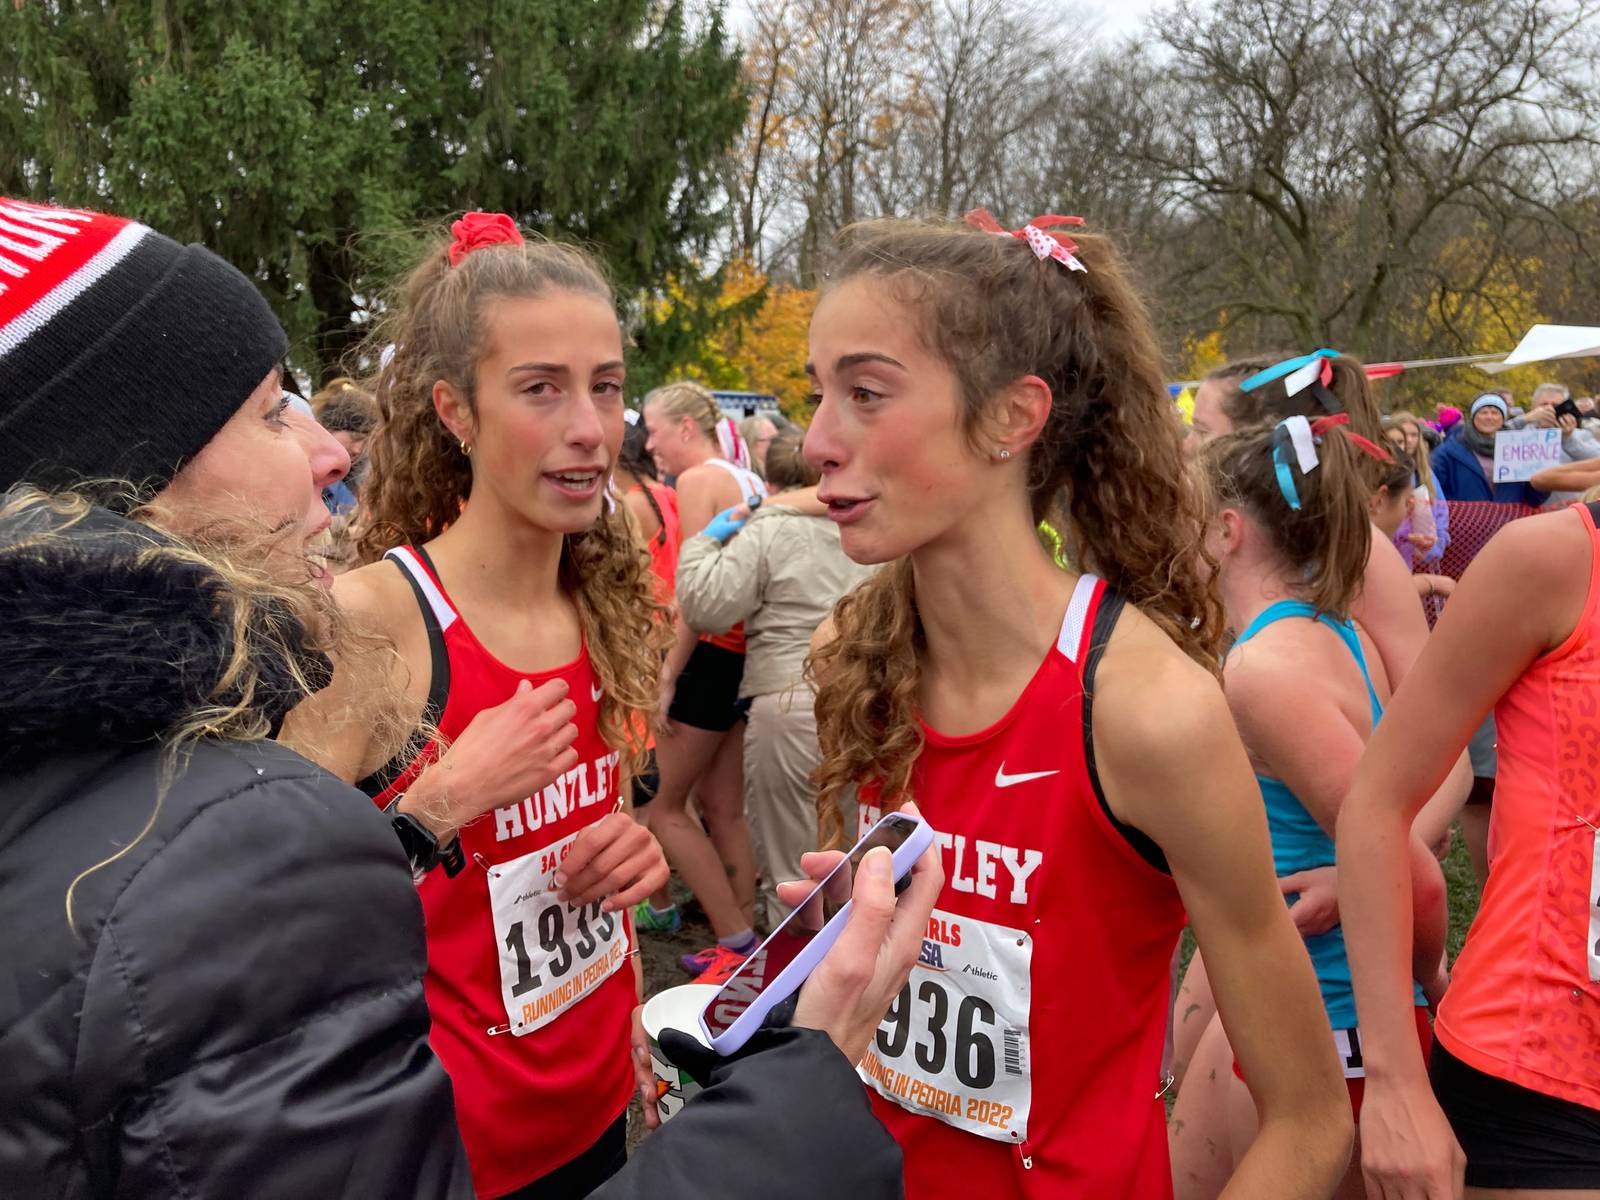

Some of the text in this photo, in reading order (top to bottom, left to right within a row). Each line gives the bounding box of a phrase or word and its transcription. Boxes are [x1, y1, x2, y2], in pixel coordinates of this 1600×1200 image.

[1502, 441, 1560, 461] EMBRACE
[494, 750, 620, 842] HUNTLEY
[522, 981, 572, 1025] RUNNING
[572, 972, 582, 996] IN
[962, 964, 998, 981] Athletic
[873, 981, 996, 1090] 936
[893, 1071, 911, 1097] IN
[909, 1079, 962, 1117] PEORIA
[966, 1098, 1013, 1129] 2022
